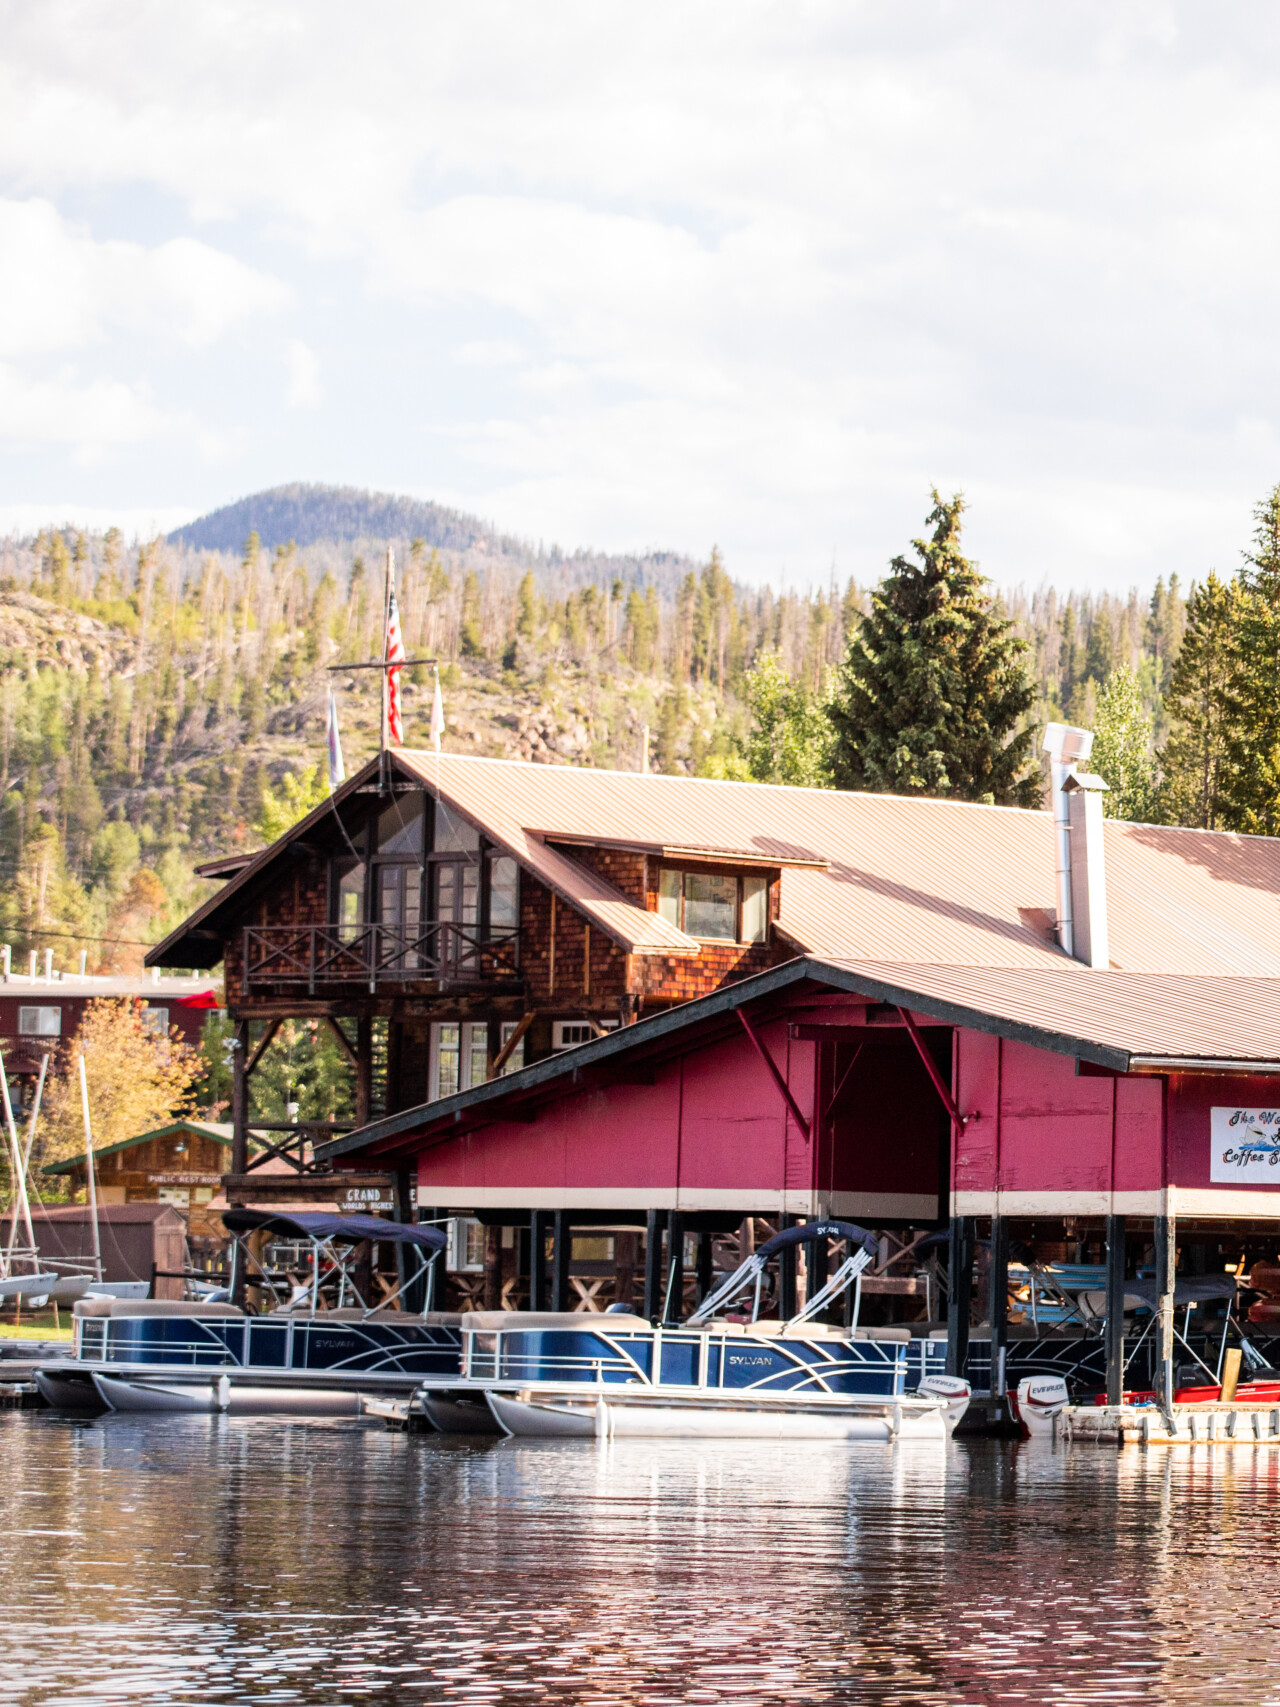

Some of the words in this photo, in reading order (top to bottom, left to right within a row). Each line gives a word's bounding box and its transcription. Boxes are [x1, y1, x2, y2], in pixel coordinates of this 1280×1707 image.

[1229, 1111, 1255, 1126] The
[1223, 1148, 1264, 1167] Coffee
[347, 1189, 380, 1201] GRAND
[729, 1356, 773, 1366] SYLVAN
[1032, 1383, 1066, 1394] EVINRUDE
